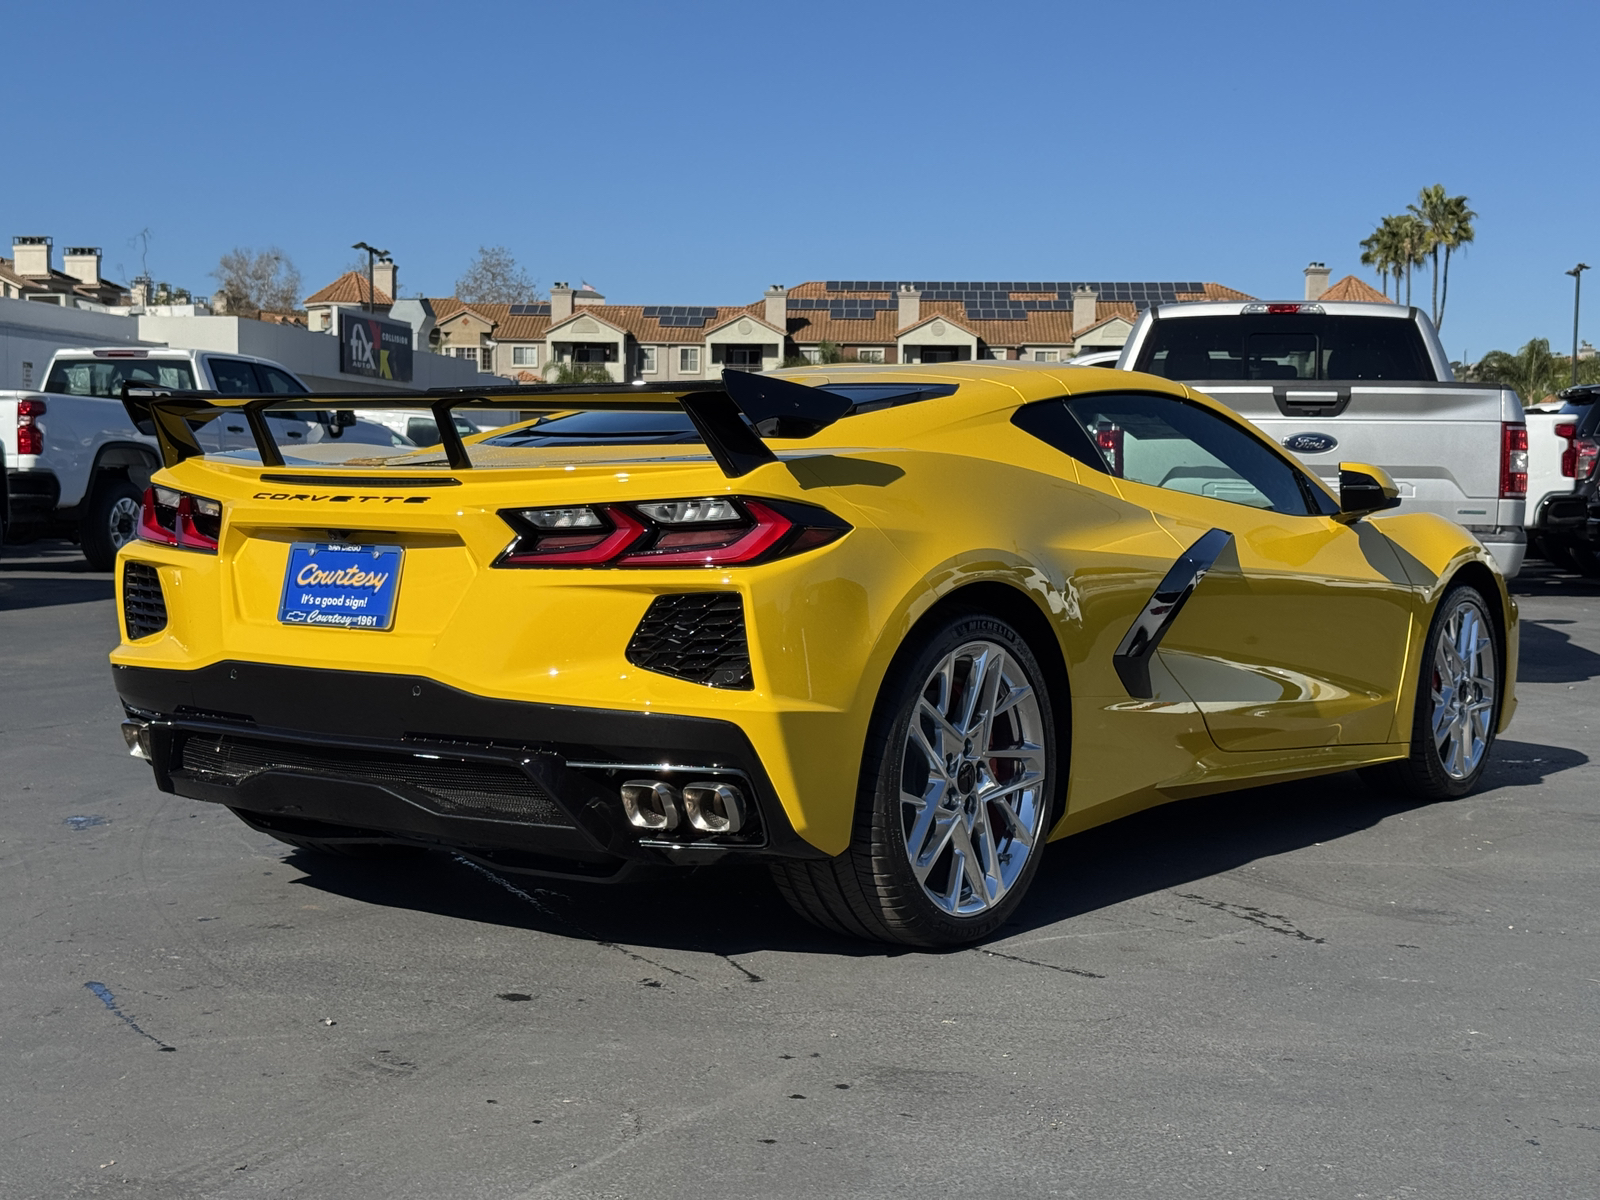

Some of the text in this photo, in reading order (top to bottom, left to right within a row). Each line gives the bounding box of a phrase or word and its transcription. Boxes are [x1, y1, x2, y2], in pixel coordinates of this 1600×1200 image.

[381, 332, 409, 345] COLLISION
[352, 361, 371, 369] AUTO
[1295, 436, 1325, 449] Ford
[252, 492, 432, 504] CORVETTE
[297, 563, 389, 593] Courtesy
[301, 593, 315, 605] It's
[321, 594, 345, 608] good
[345, 596, 368, 610] sign!
[307, 610, 351, 627] Courtesy
[357, 615, 377, 626] 1961
[969, 620, 1015, 641] MICHELIN
